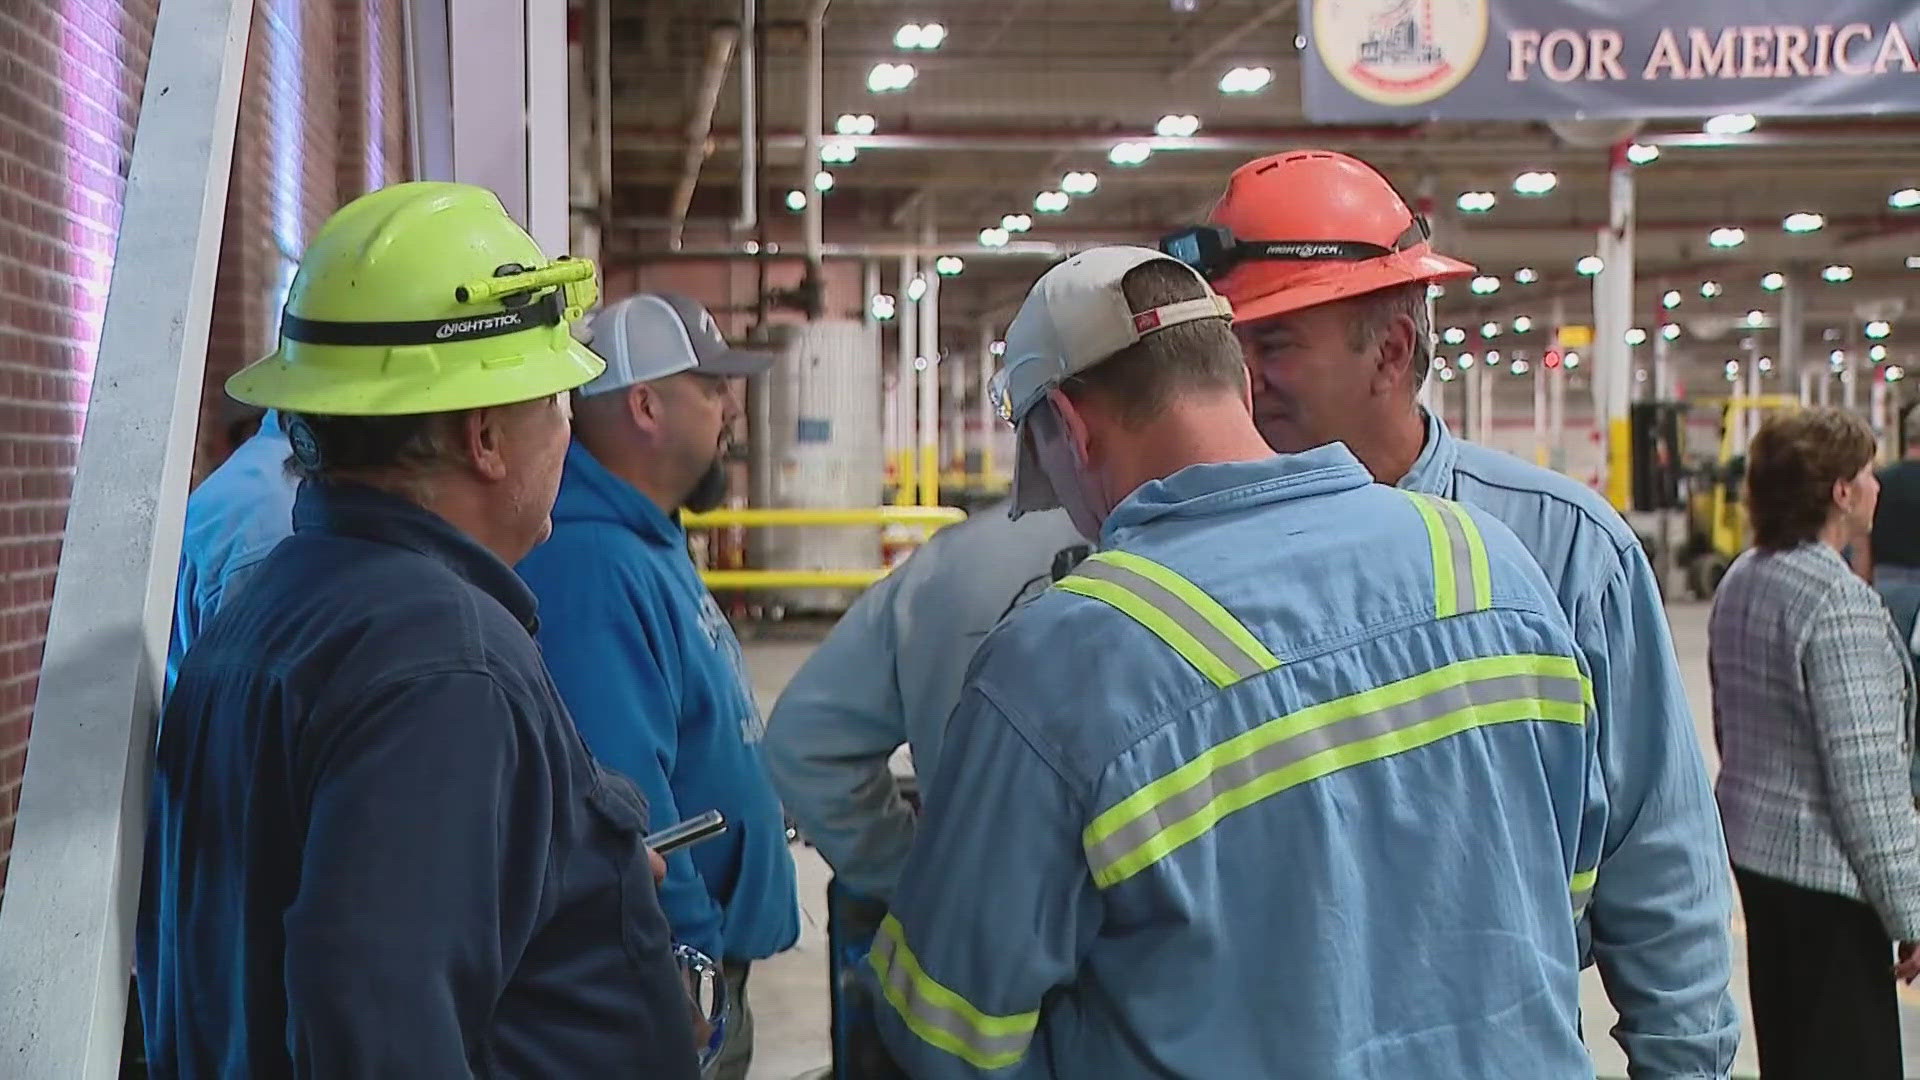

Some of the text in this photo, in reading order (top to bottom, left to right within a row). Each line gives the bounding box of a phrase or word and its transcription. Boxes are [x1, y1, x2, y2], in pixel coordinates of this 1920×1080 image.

[1507, 29, 1628, 83] FOR
[1642, 20, 1920, 80] AMERICA
[437, 313, 519, 338] NIGHTSTICK
